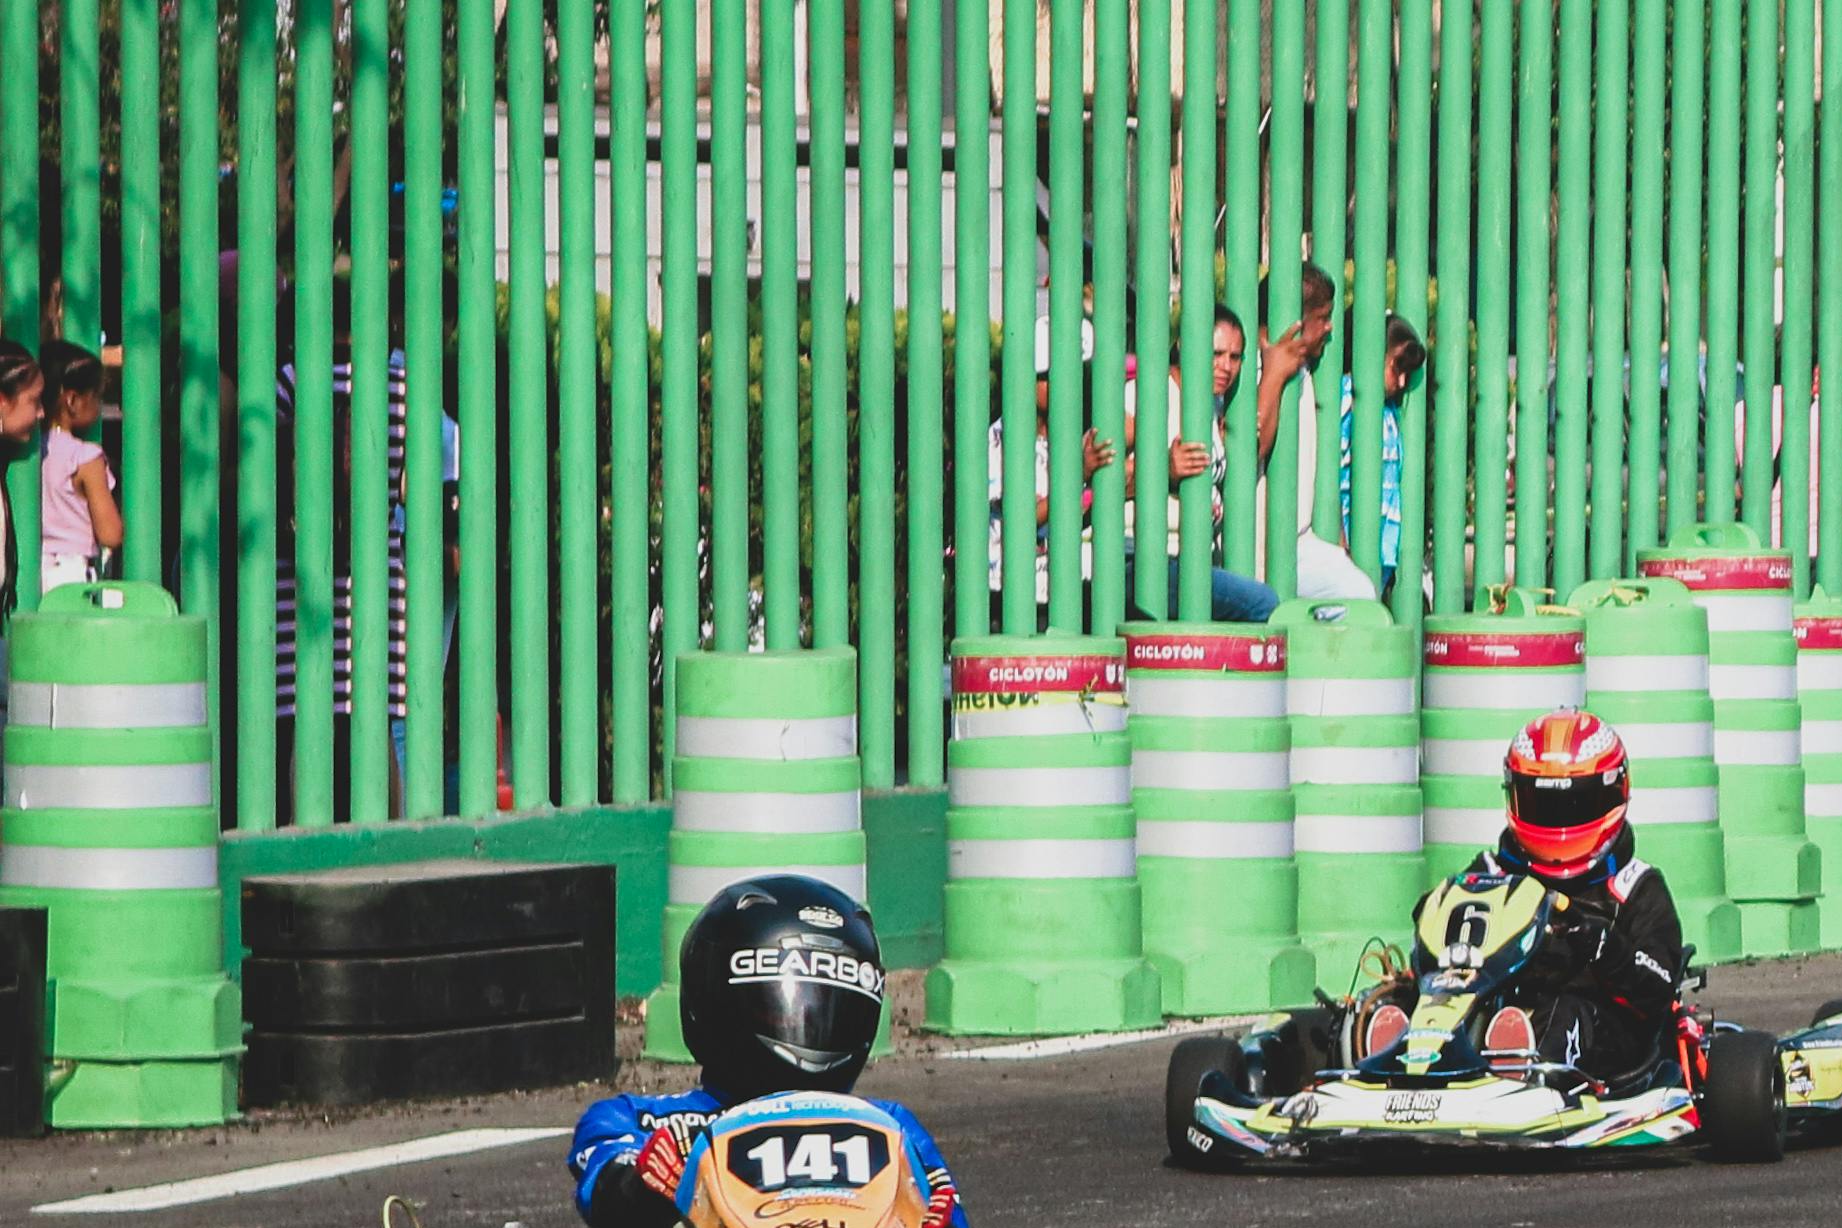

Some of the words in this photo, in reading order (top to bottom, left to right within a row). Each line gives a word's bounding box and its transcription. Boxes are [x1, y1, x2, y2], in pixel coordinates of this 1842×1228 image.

[989, 665, 1068, 682] CICLOTÓN
[1134, 643, 1205, 660] CICLOTÓN
[1444, 901, 1491, 948] 6
[729, 947, 884, 995] GEARBOX
[747, 1133, 870, 1187] 141
